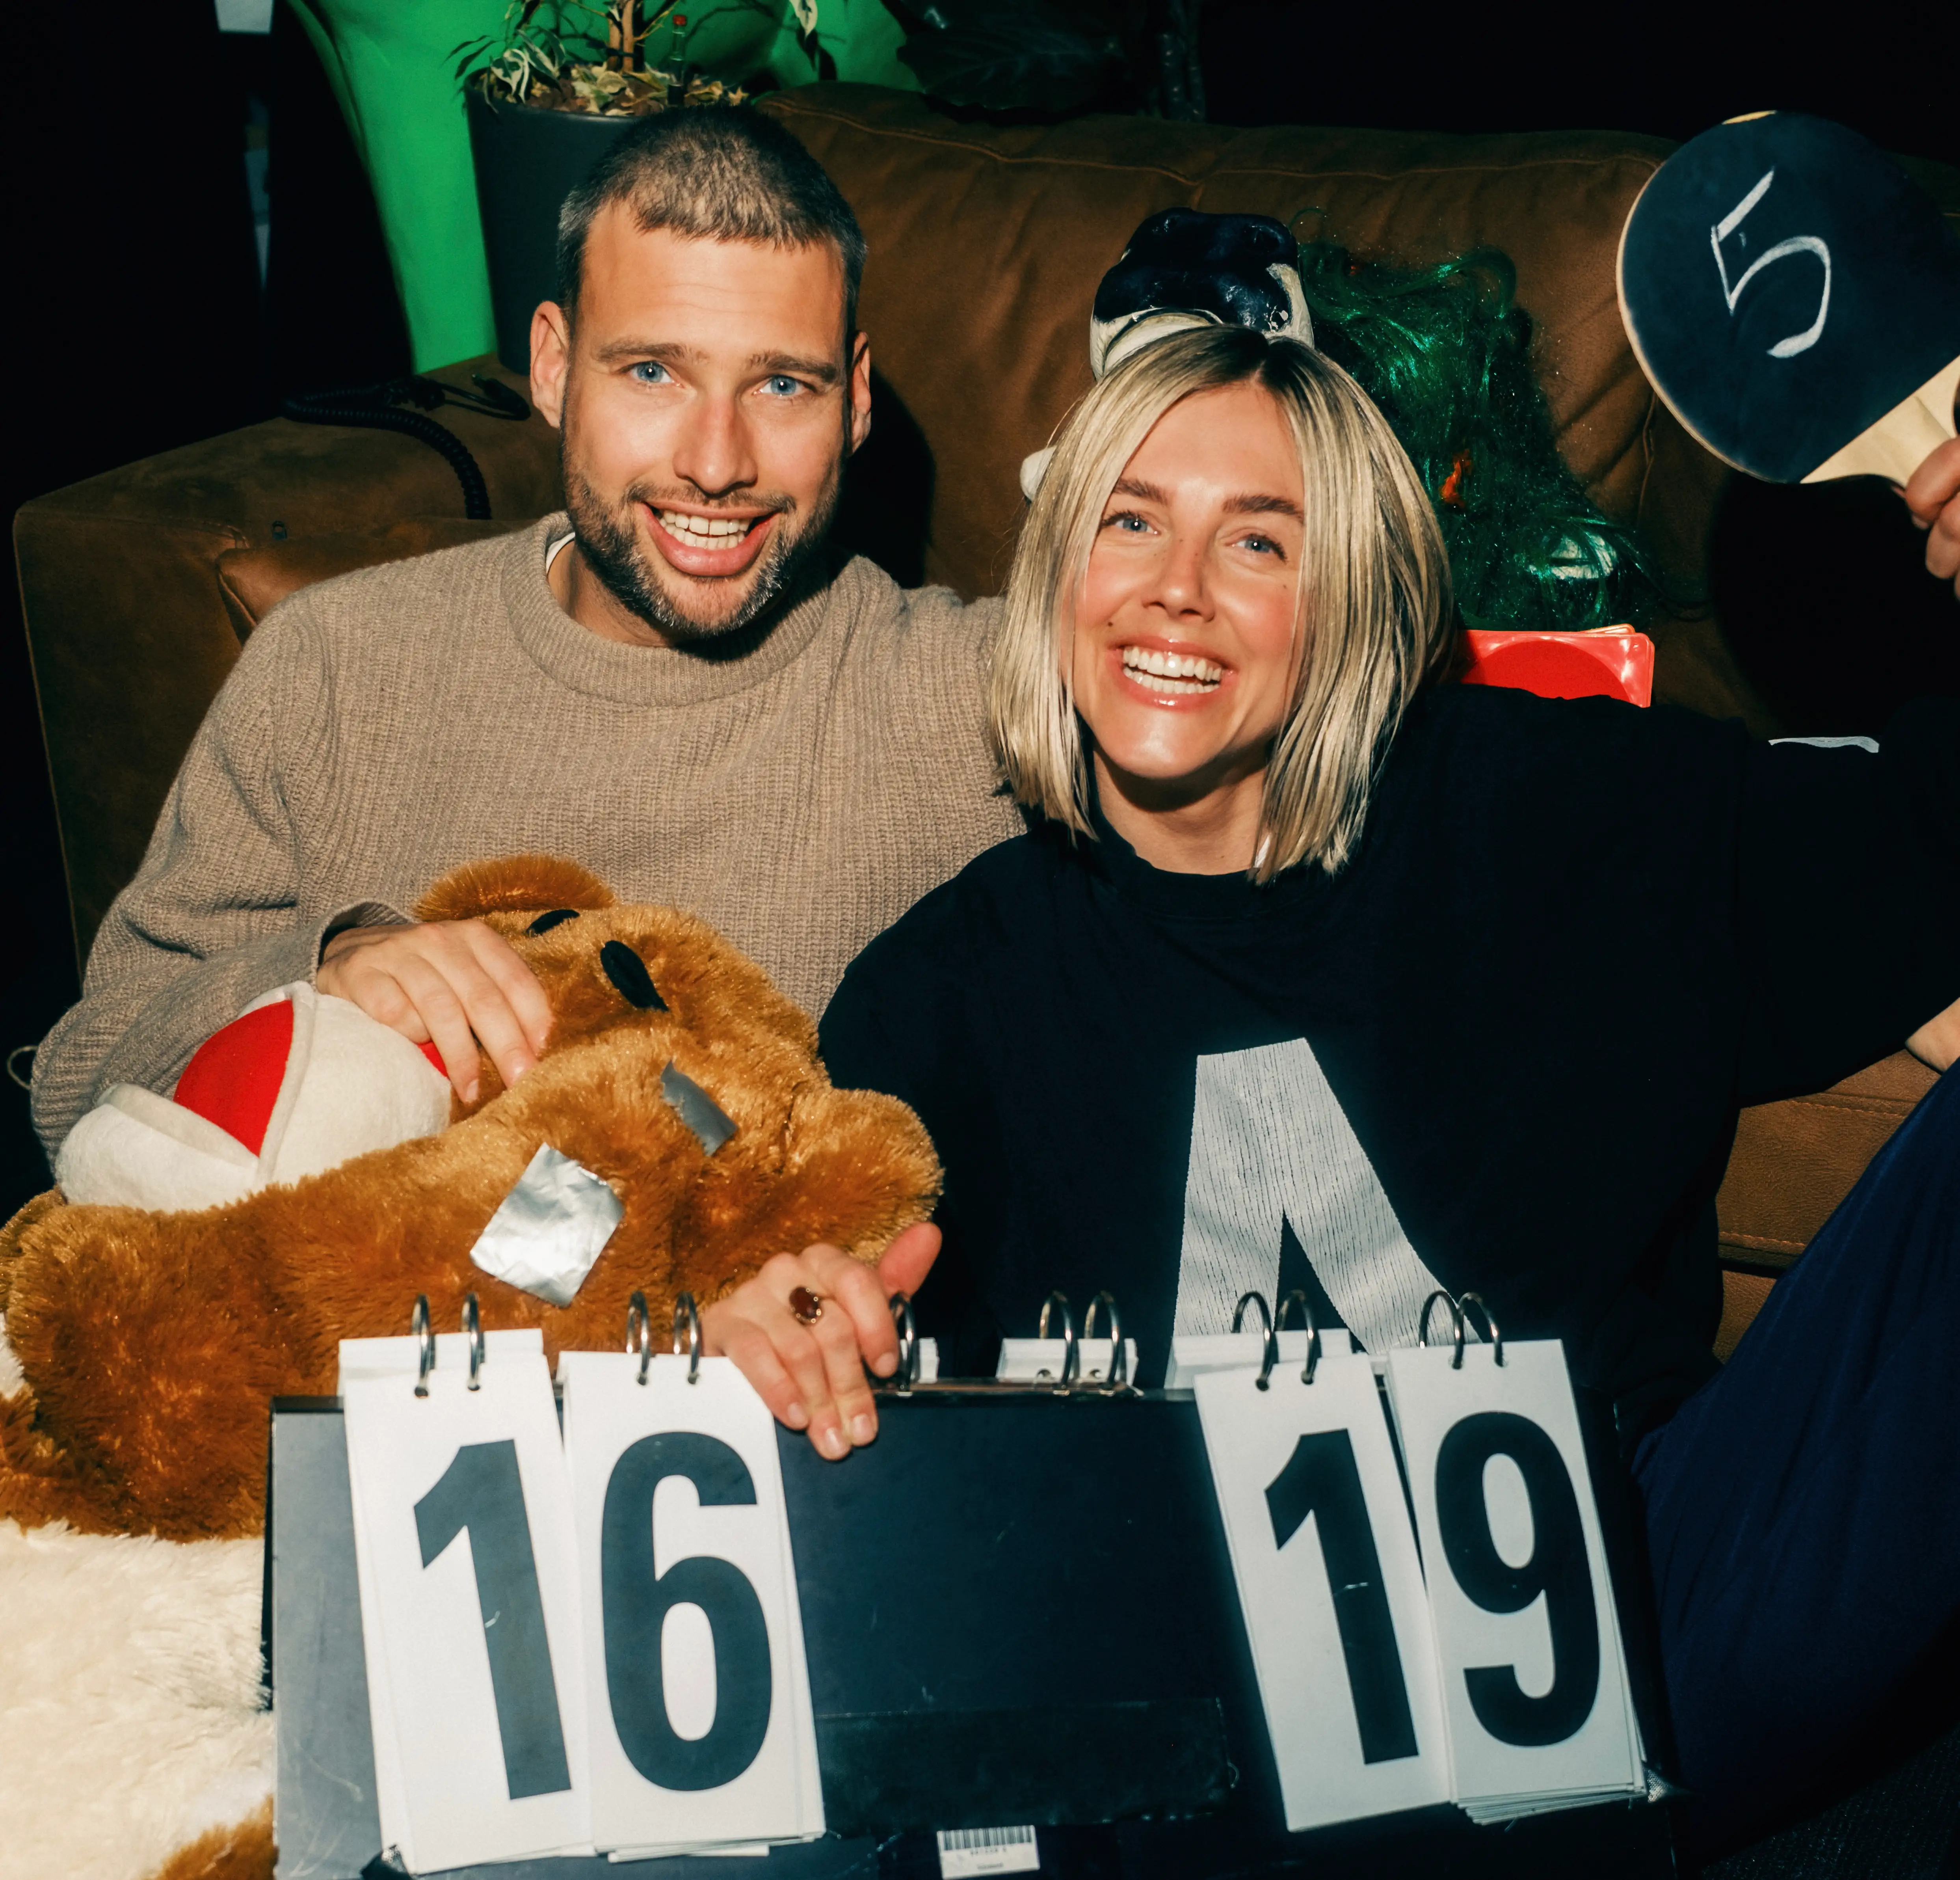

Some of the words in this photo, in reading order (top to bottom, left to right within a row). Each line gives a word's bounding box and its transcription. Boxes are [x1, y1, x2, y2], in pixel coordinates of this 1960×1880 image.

[1711, 166, 1831, 358] 5
[414, 1431, 772, 1800] 16
[1264, 1411, 1601, 1765] 19
